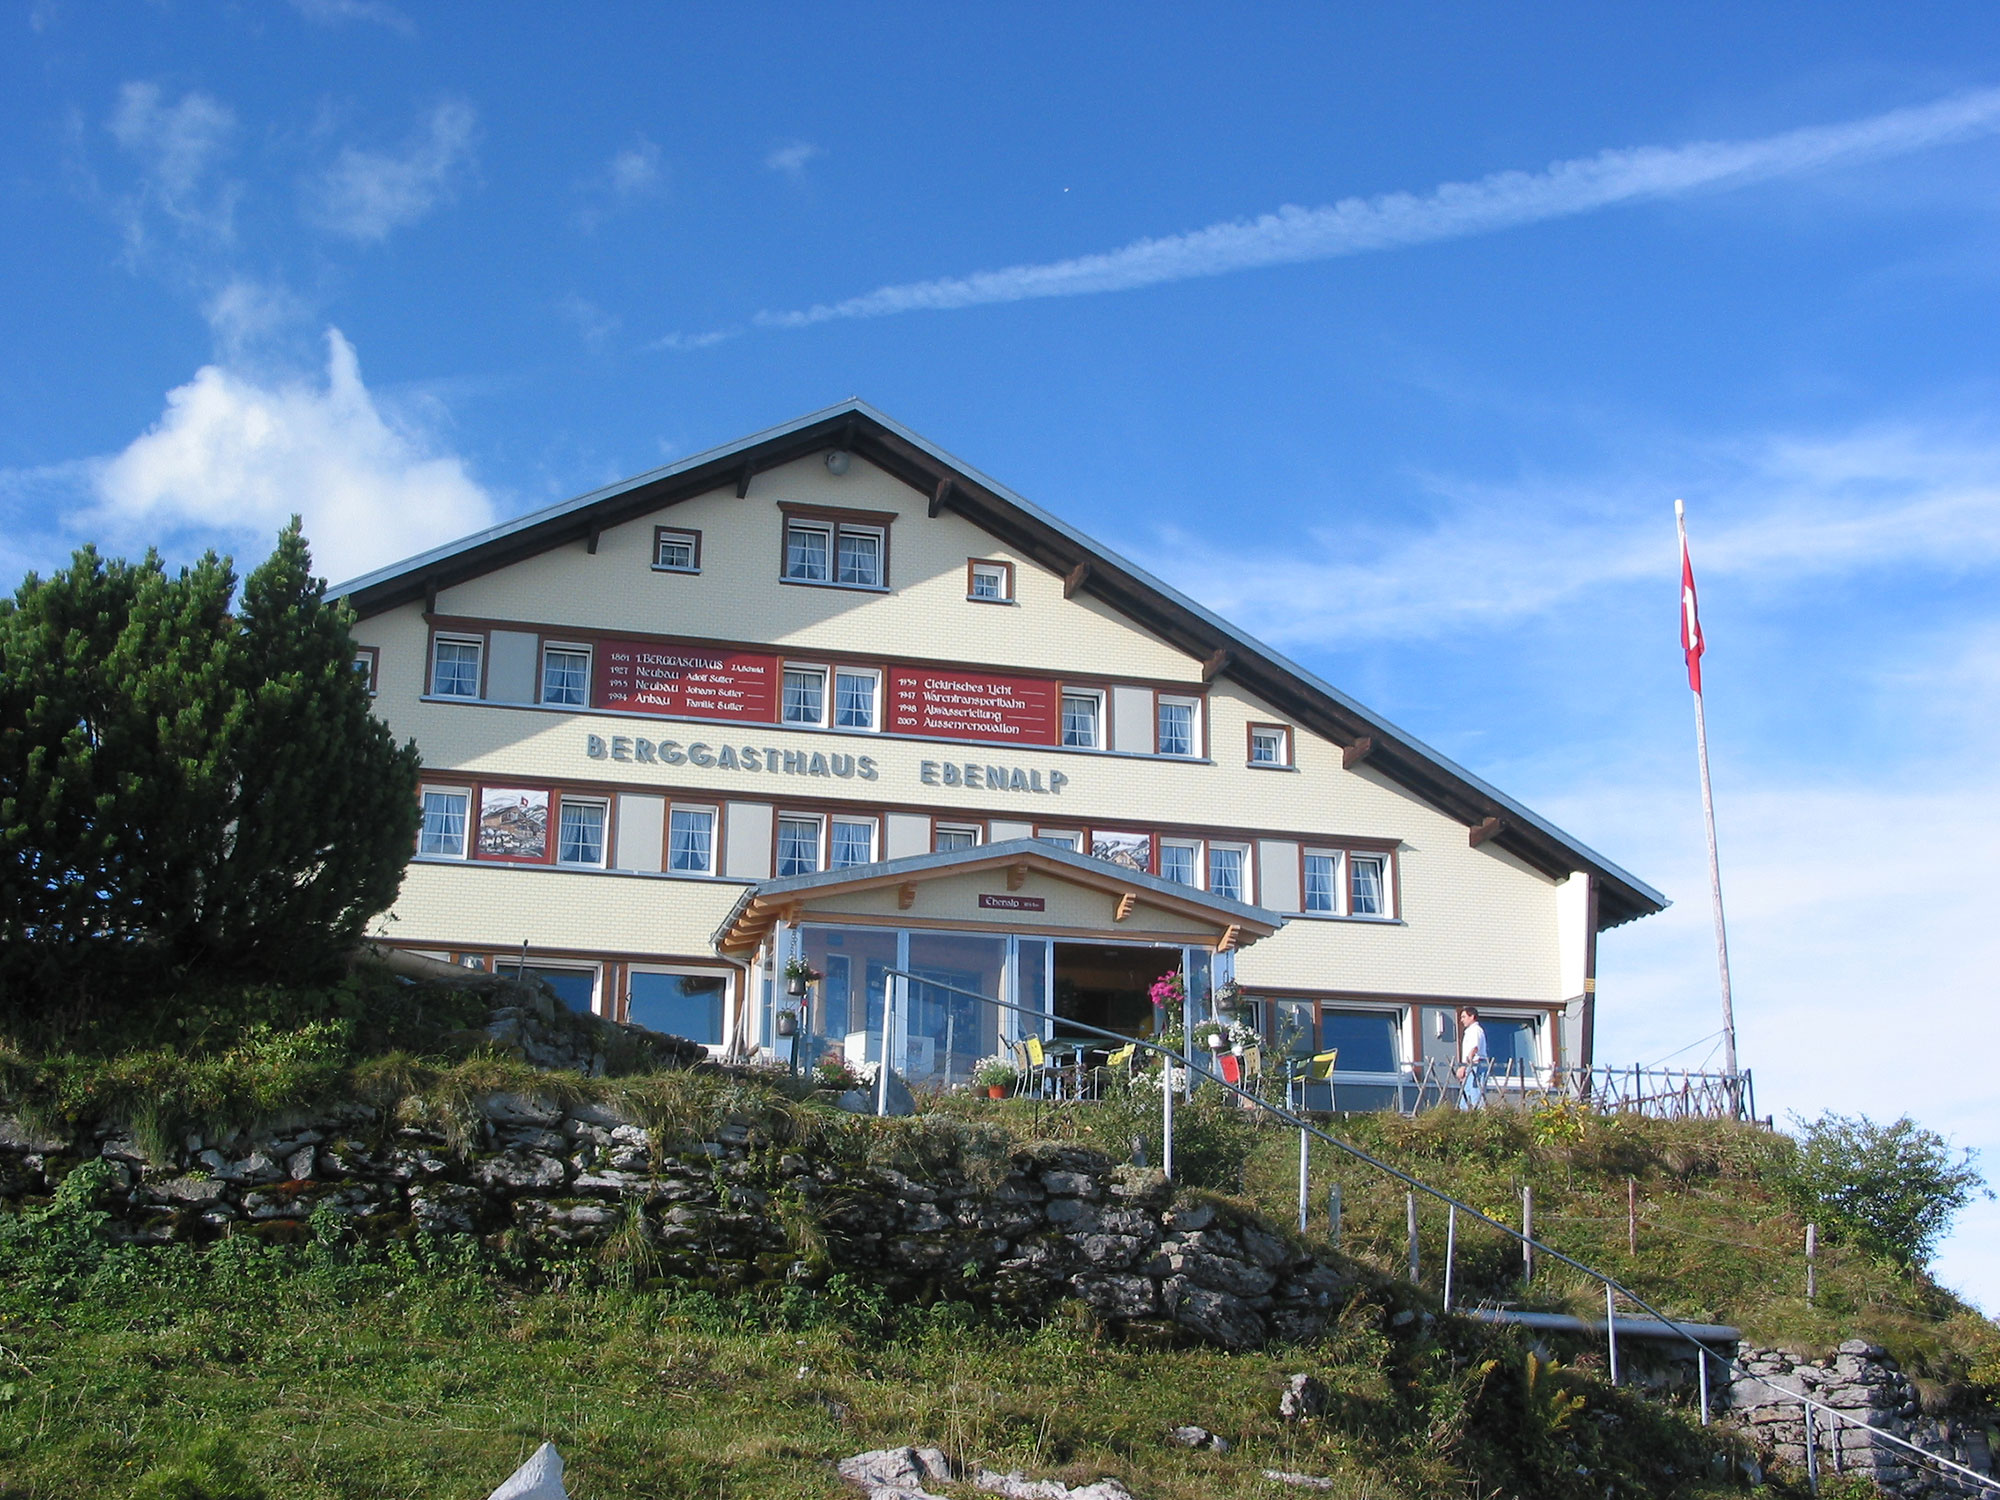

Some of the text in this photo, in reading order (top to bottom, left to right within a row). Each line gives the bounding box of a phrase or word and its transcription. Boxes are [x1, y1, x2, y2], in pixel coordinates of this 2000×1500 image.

[609, 666, 735, 684] 1927 Neubau Adolf Sutter
[635, 679, 679, 693] Neubau
[685, 685, 716, 696] Johann
[717, 688, 745, 698] Sutter
[986, 684, 1012, 696] Licht
[634, 692, 671, 706] Anbau
[686, 698, 715, 709] Familie
[717, 701, 745, 711] Sutter
[922, 690, 1026, 709] Warentransportbahn
[923, 704, 1002, 723] Abwasserleitung
[923, 717, 1020, 735] Aussenrenovation
[586, 733, 1067, 794] BERGGASTHAUS EBENALP
